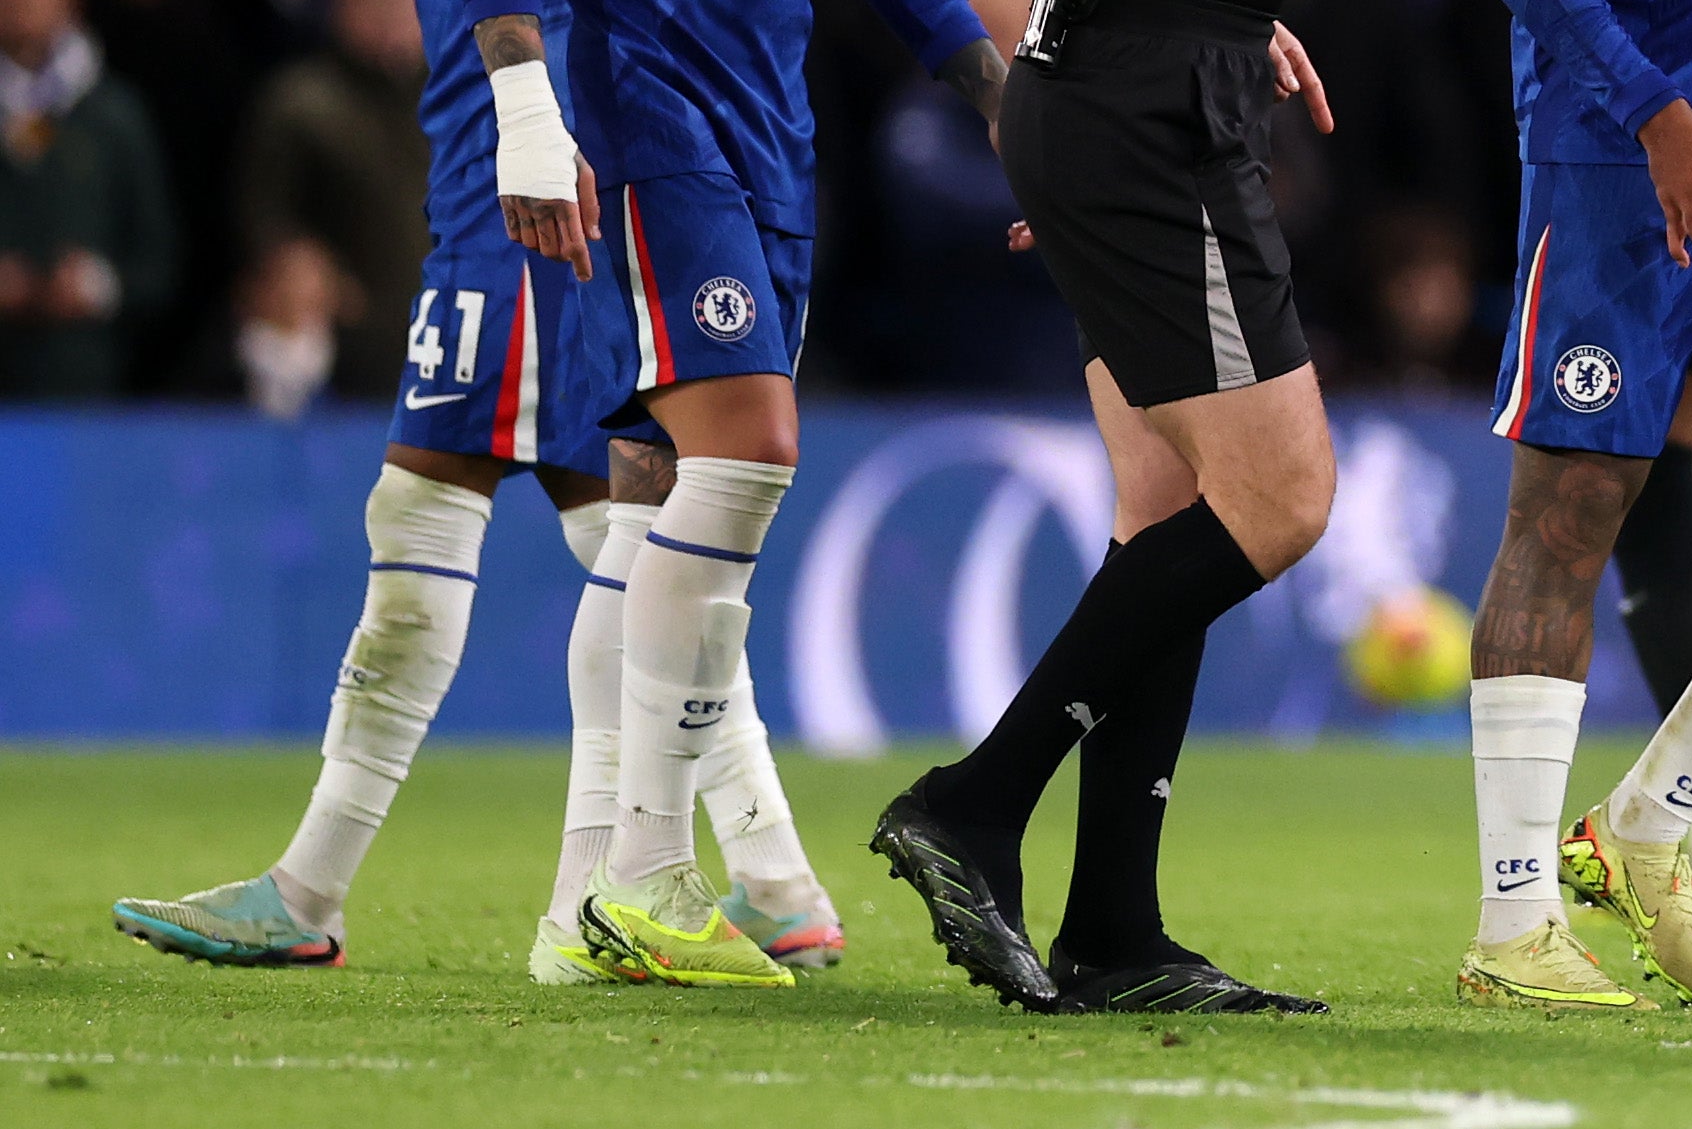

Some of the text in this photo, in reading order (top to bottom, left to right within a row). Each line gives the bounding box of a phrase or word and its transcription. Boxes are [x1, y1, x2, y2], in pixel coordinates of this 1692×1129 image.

[701, 279, 742, 296] CHELSEA
[407, 289, 486, 384] 41
[1569, 348, 1612, 366] CHELSEA
[684, 699, 730, 714] CFC
[1495, 858, 1540, 875] CFC
